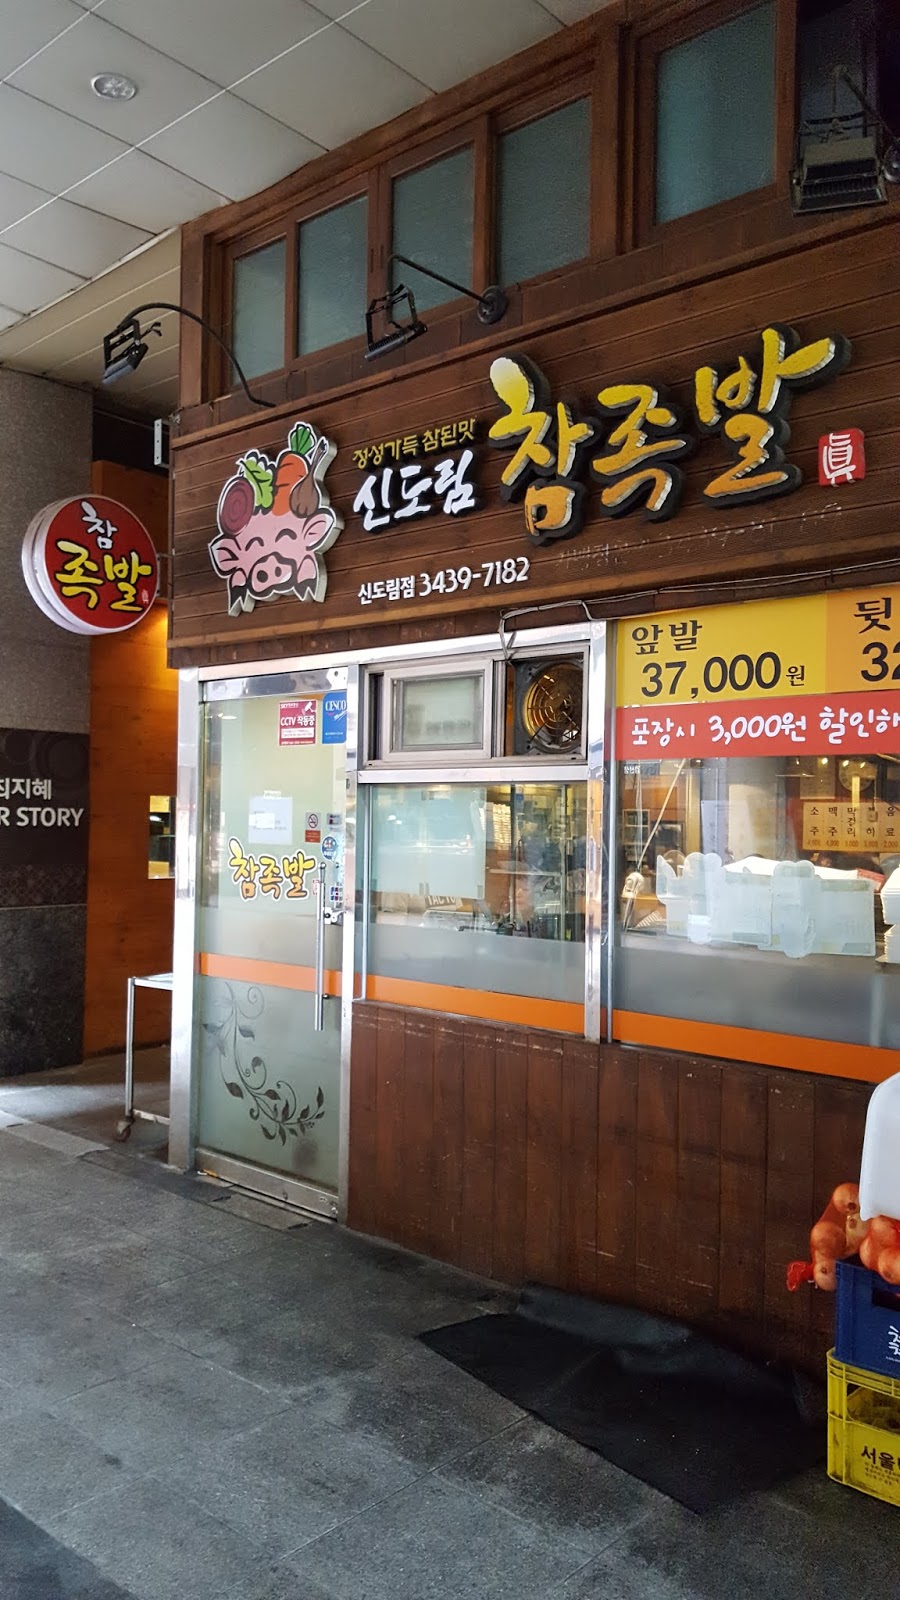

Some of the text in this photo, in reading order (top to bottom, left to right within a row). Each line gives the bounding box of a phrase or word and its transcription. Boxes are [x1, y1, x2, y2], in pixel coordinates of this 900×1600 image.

[352, 417, 477, 469] 정성가득 참된맛
[488, 327, 838, 536] 참족발
[353, 449, 476, 531] 신도림
[81, 500, 118, 550] 참
[55, 539, 154, 613] 족발
[357, 556, 531, 605] 신도림점 3439-7182
[280, 716, 297, 727] CCTV
[325, 700, 347, 712] CESCO
[631, 717, 695, 747] 포장시
[708, 711, 806, 745] 3,000원
[16, 807, 84, 827] STORY
[228, 837, 316, 900] 참족발
[861, 1445, 900, 1472] 서울
